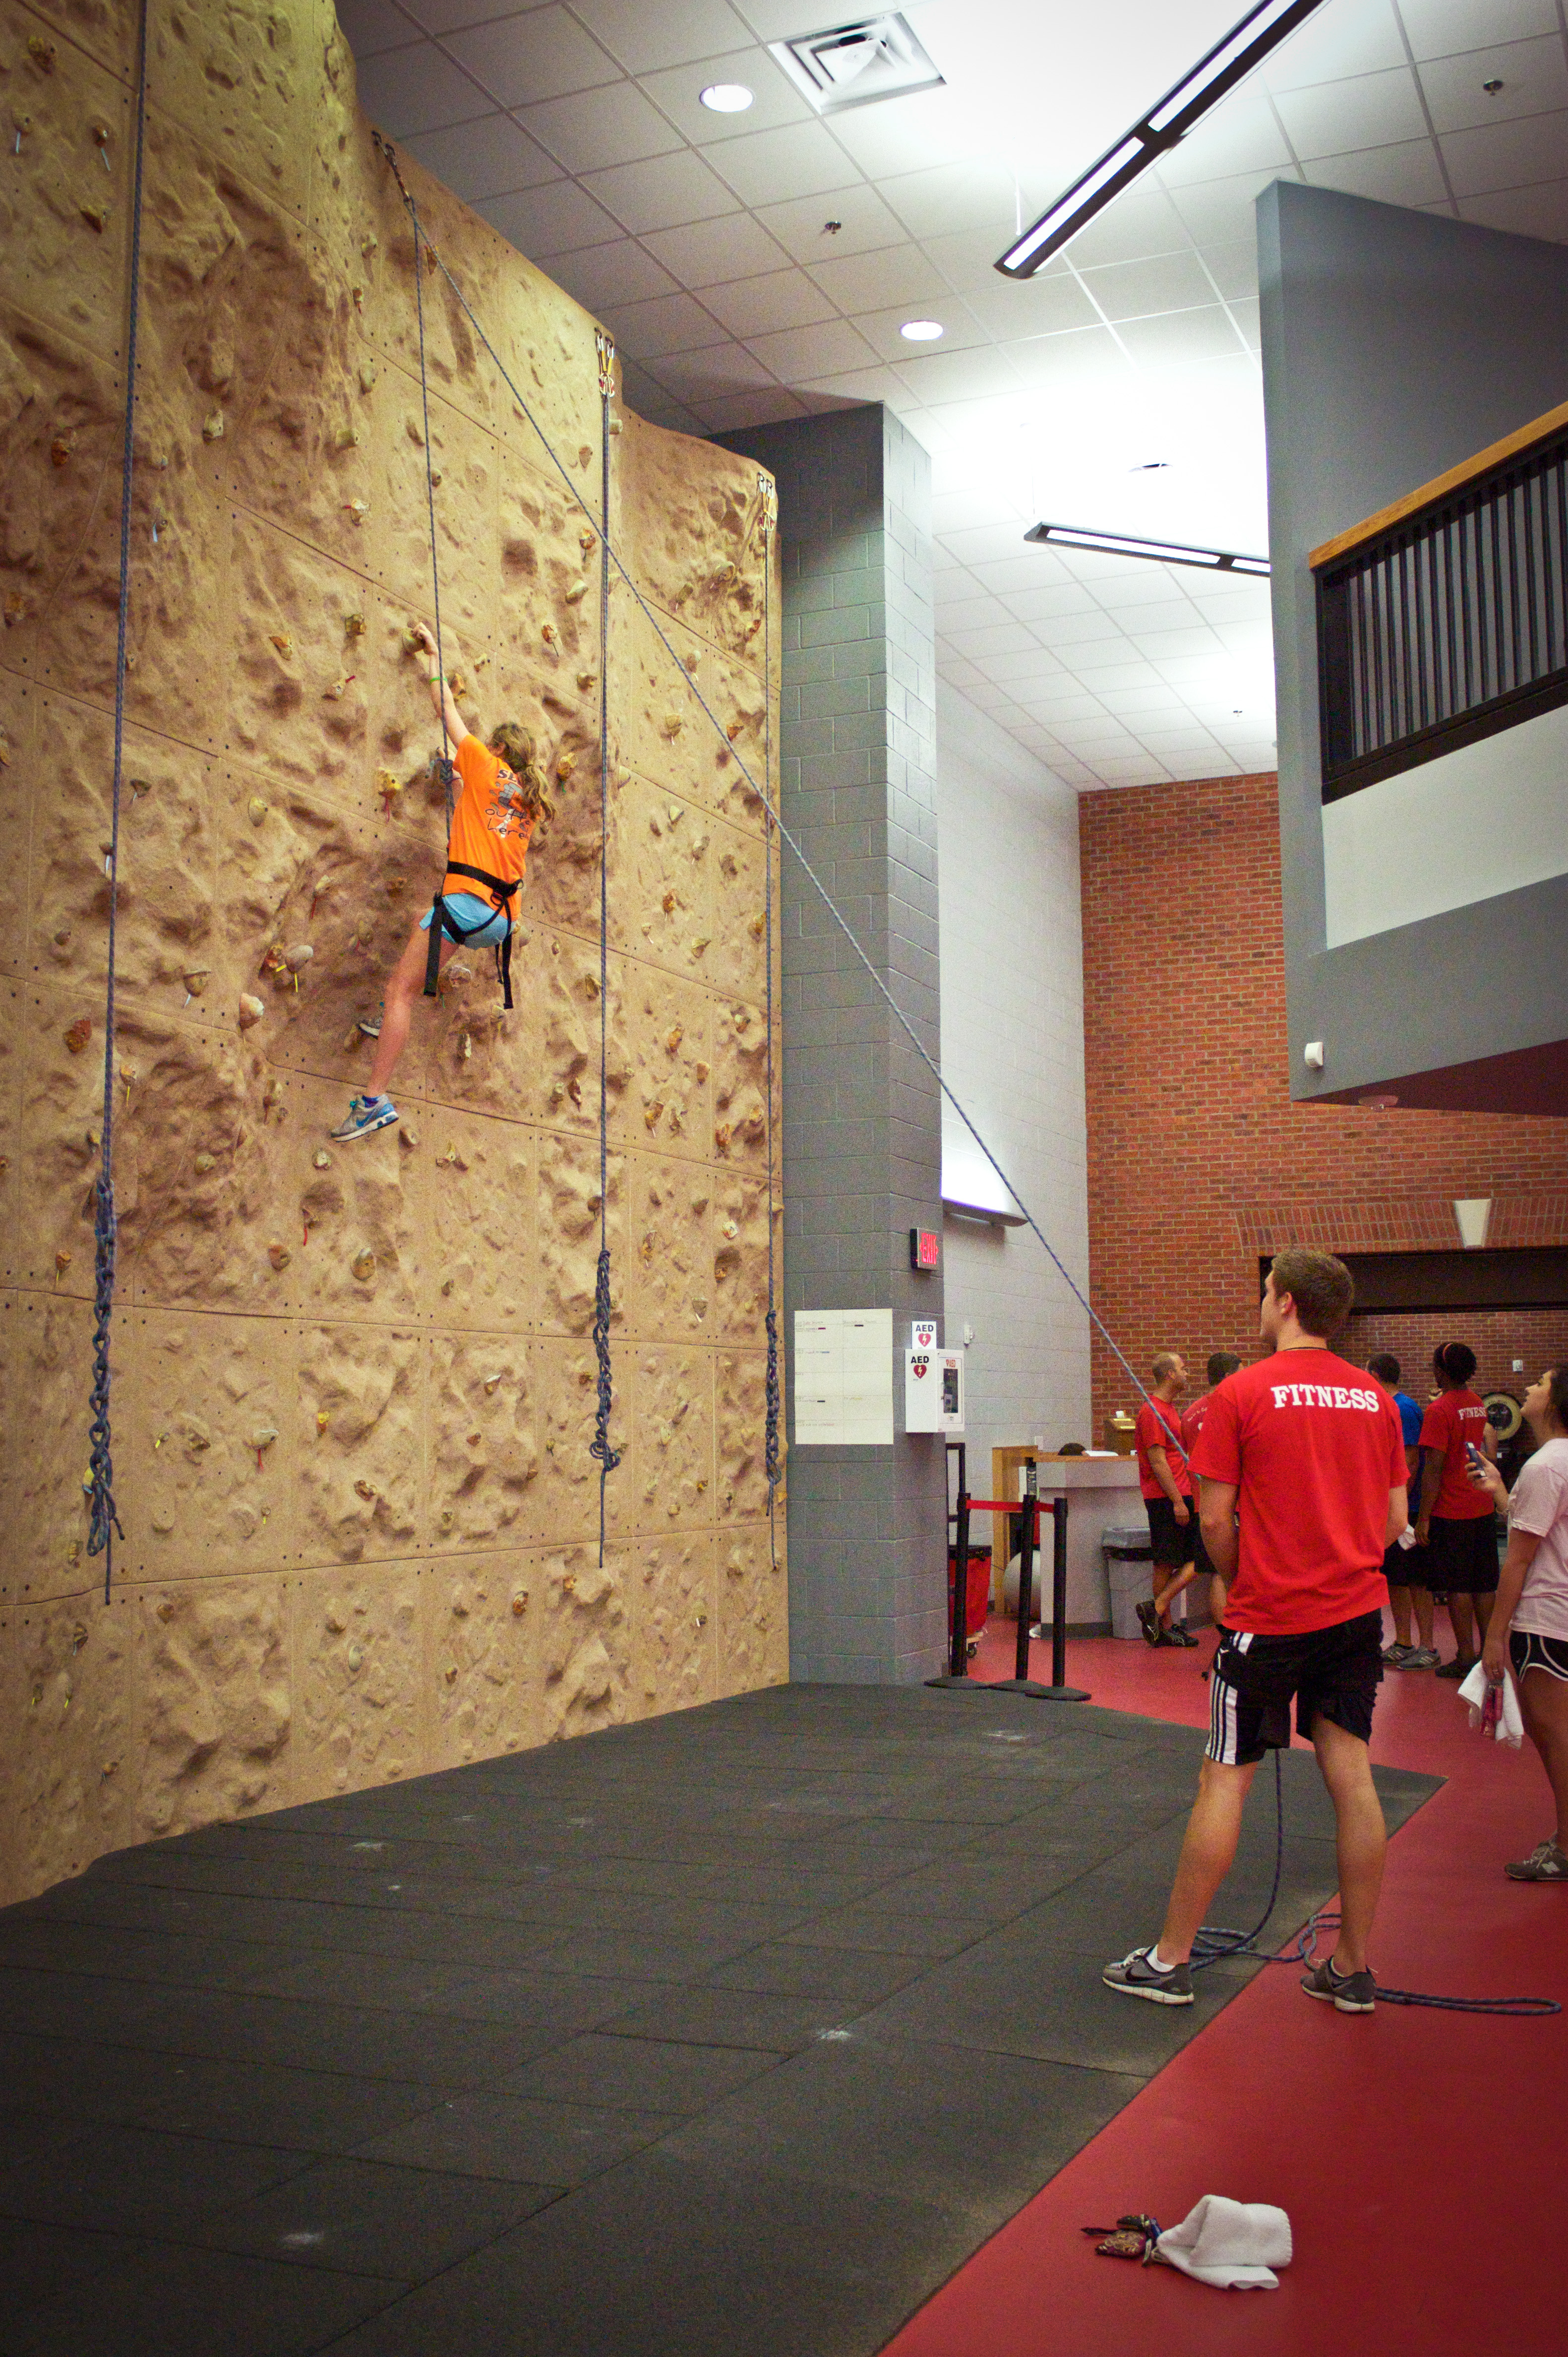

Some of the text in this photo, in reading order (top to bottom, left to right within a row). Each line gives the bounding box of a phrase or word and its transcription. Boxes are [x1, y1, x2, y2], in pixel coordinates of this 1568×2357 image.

[921, 1233, 937, 1265] EXIT
[1270, 1384, 1380, 1413] FITNESS
[1458, 1406, 1487, 1420] FTNESS
